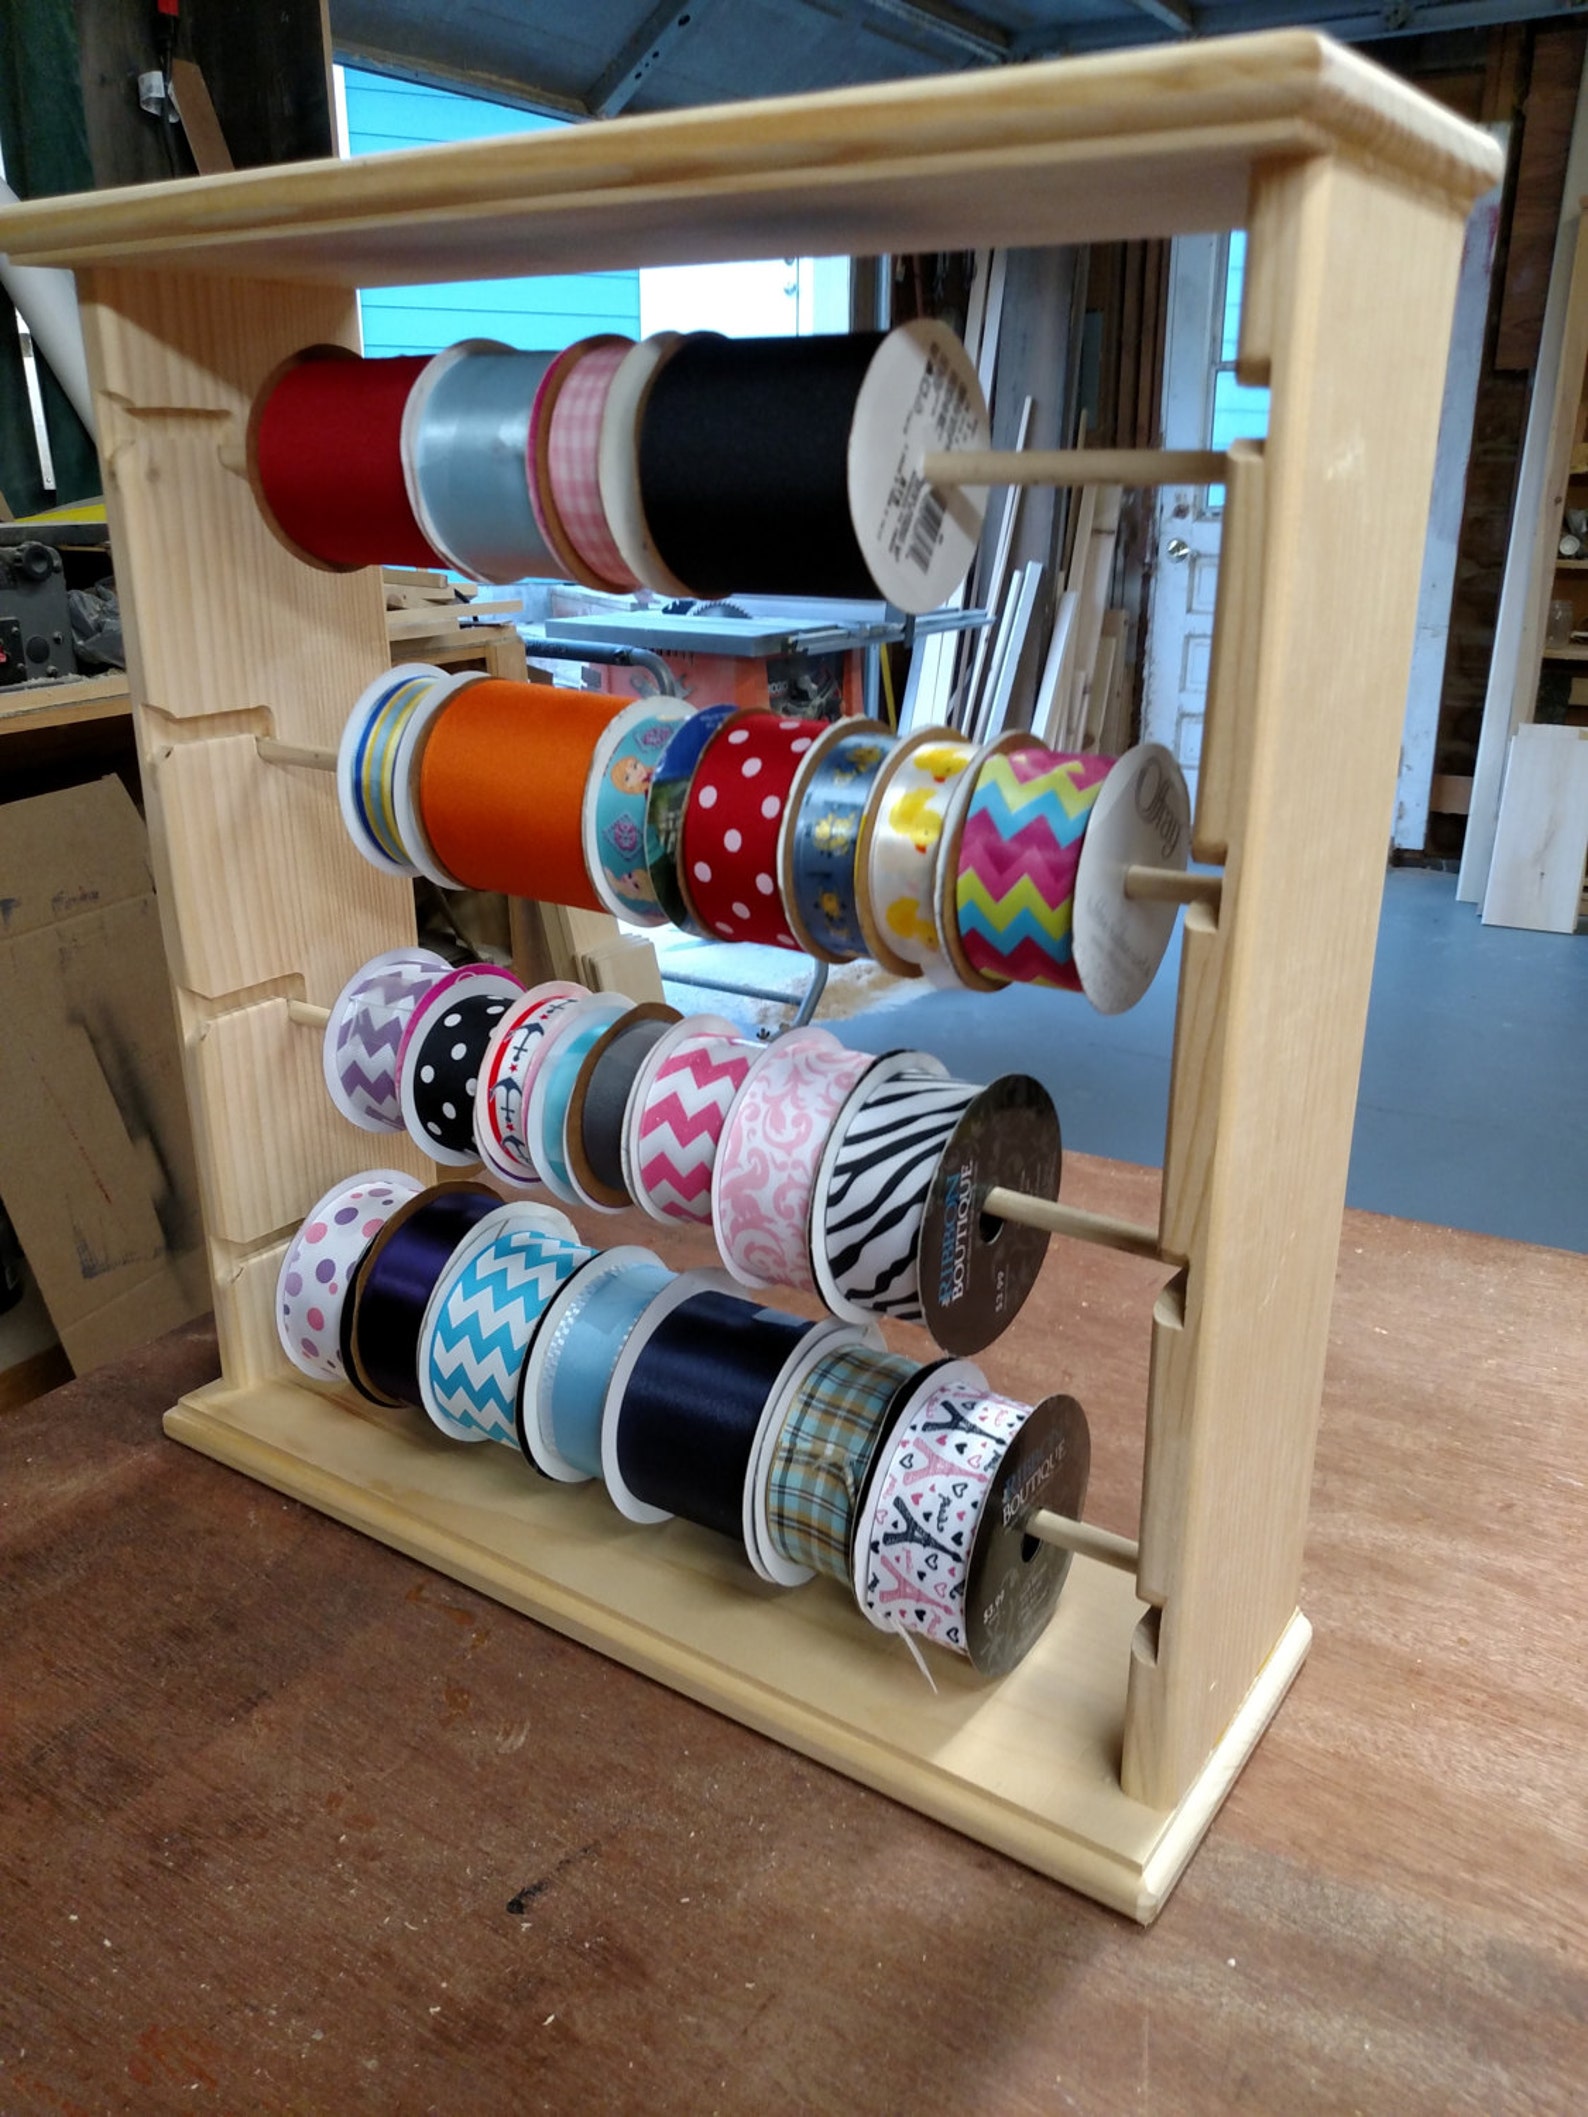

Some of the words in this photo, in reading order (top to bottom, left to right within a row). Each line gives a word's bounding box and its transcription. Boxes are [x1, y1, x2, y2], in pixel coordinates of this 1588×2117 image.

[1135, 756, 1180, 860] Offray
[938, 1171, 961, 1306] RIBBON
[952, 1160, 974, 1302] BOUTIQUE
[1002, 1438, 1066, 1527] BOUTIQUE
